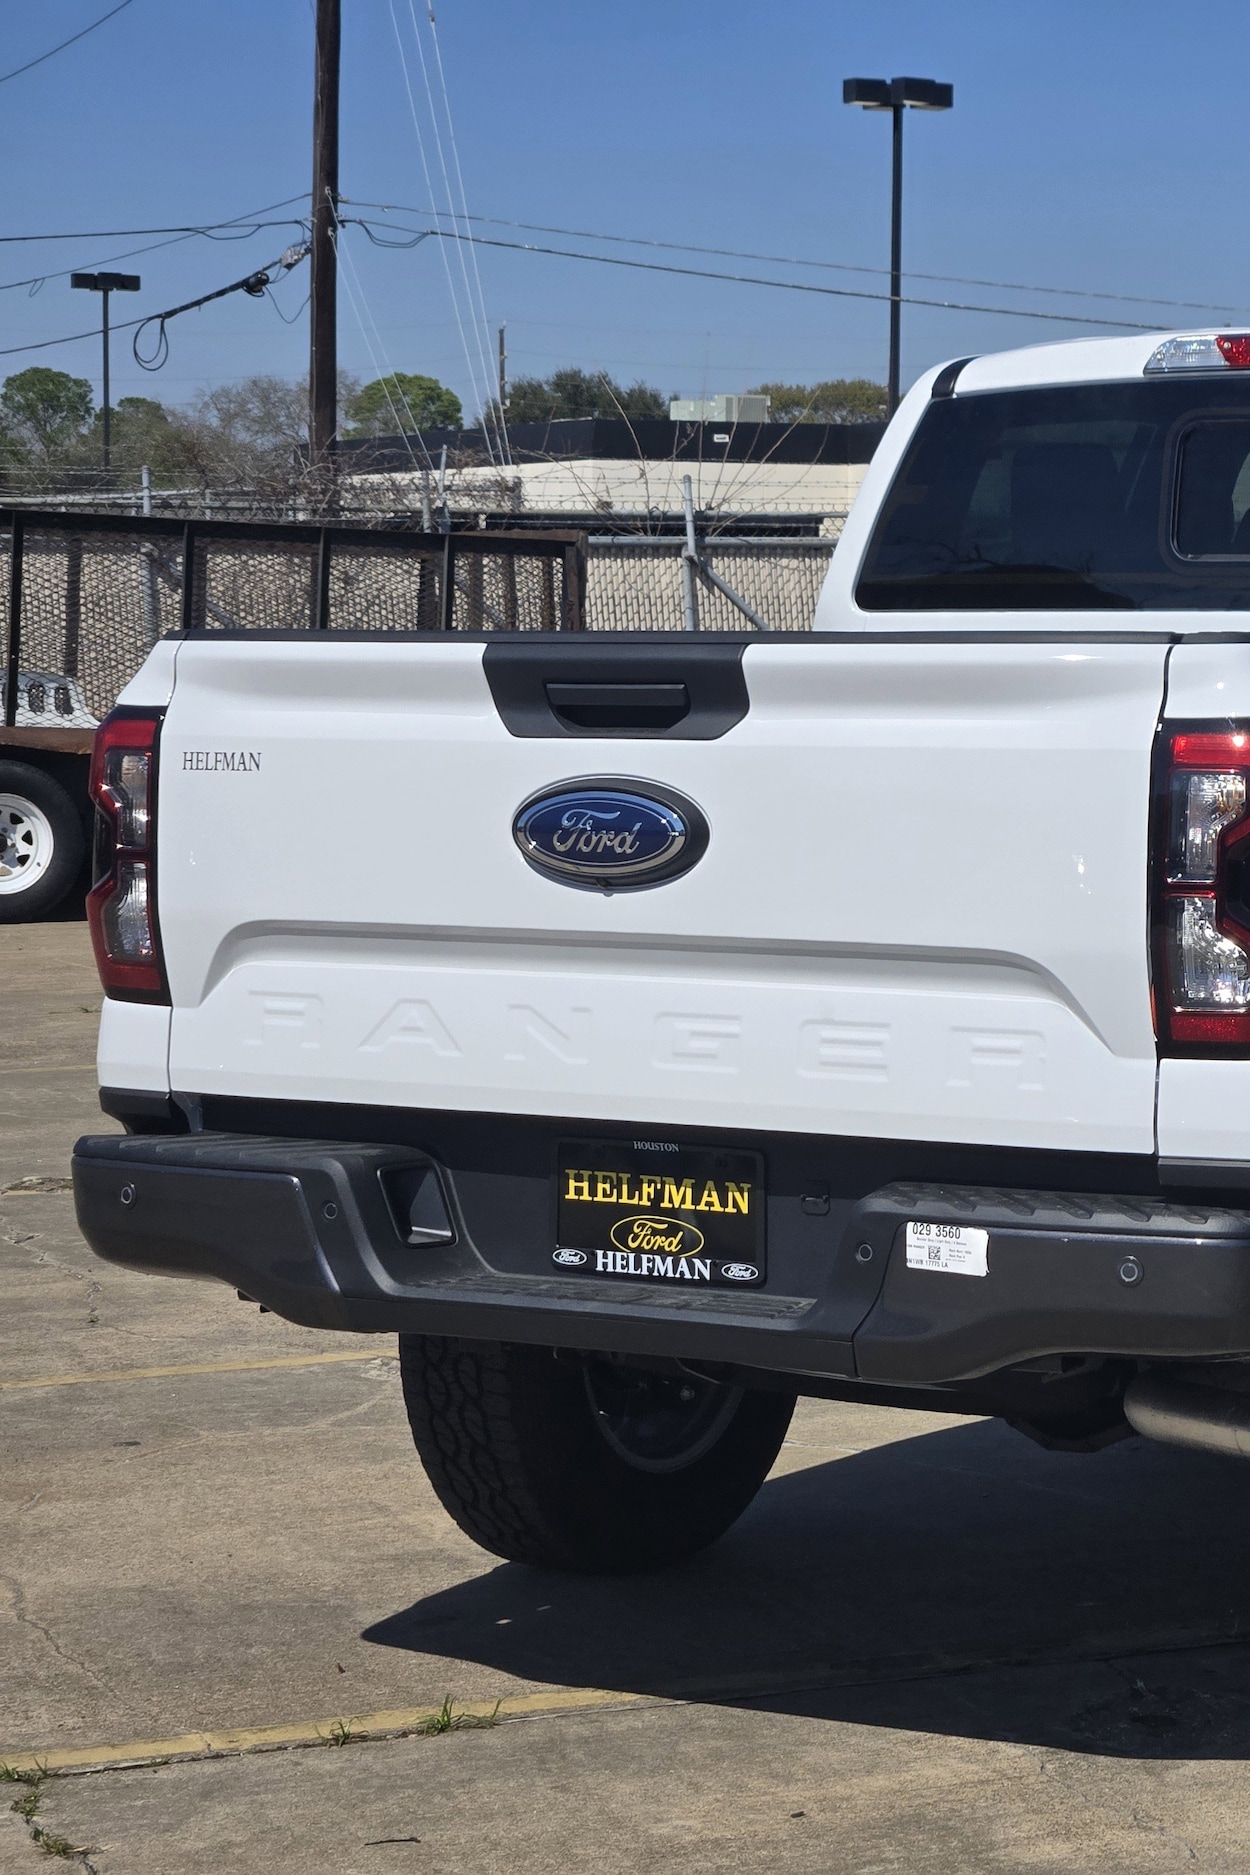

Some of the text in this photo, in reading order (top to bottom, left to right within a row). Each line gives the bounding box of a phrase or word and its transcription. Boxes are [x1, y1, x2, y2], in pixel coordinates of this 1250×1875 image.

[182, 751, 262, 772] HELFMAN
[551, 807, 641, 856] Ford
[242, 989, 1046, 1093] RANGER
[633, 1140, 680, 1152] HOUSTON
[564, 1168, 752, 1214] HELFMAN
[627, 1219, 684, 1252] Ford
[912, 1222, 960, 1239] 029 3560
[558, 1250, 581, 1263] Ford
[595, 1249, 712, 1281] HELFMAN
[728, 1264, 752, 1278] Ford
